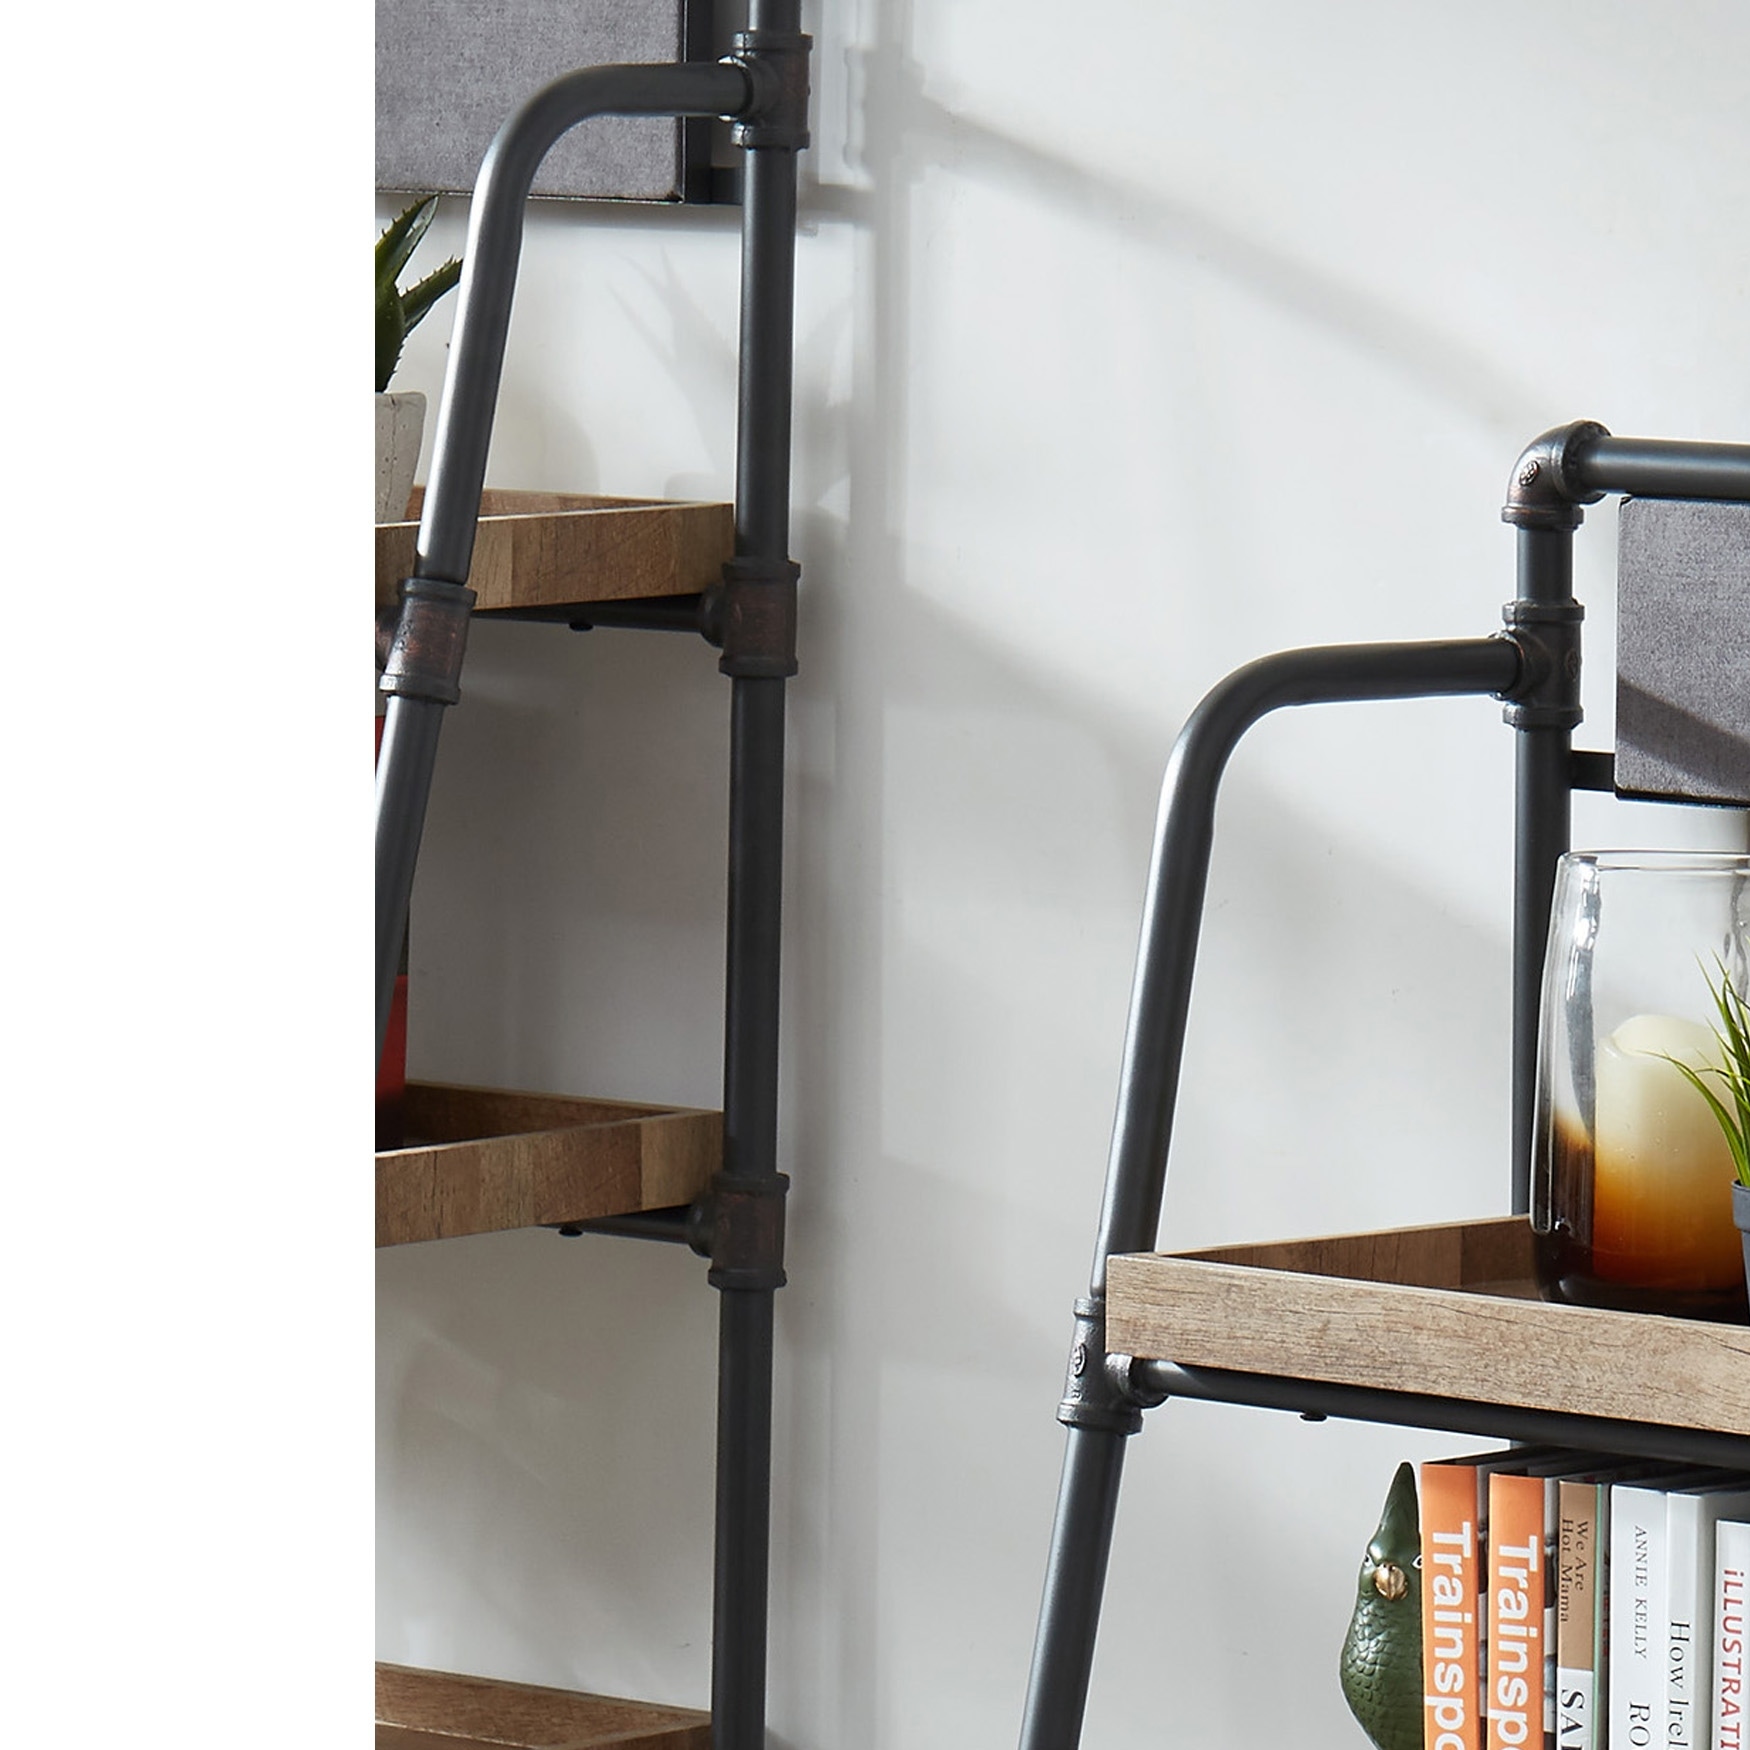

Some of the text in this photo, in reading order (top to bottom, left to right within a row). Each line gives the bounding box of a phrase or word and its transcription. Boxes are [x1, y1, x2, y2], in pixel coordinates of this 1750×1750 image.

[1560, 1518, 1574, 1623] Hot Mama
[1575, 1520, 1588, 1591] We Are
[1633, 1525, 1648, 1659] ANNIE KELLY
[1668, 1620, 1691, 1689] How
